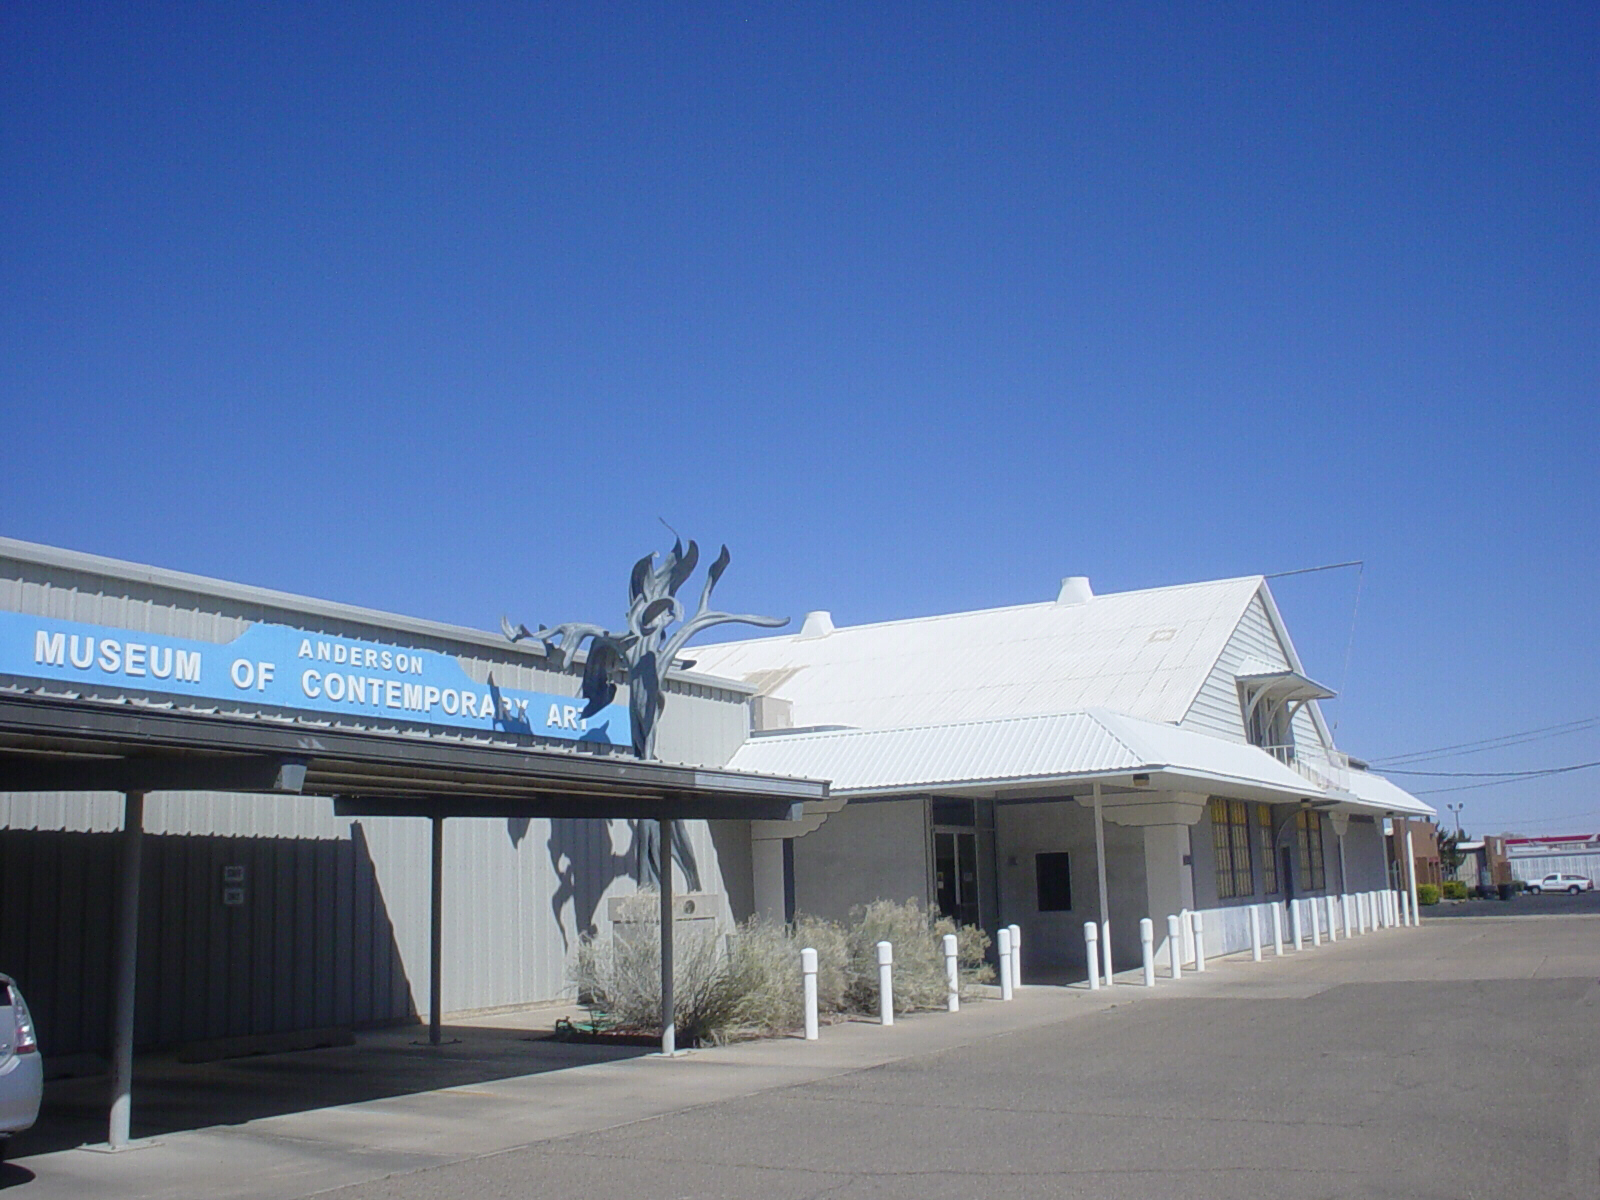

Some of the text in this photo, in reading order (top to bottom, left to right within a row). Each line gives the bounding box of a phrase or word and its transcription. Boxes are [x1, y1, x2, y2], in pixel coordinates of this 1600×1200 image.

[35, 630, 202, 682] MUSEUM
[230, 658, 275, 691] OF
[302, 669, 529, 724] CONTEMPORARY
[298, 638, 423, 675] ANDERSON
